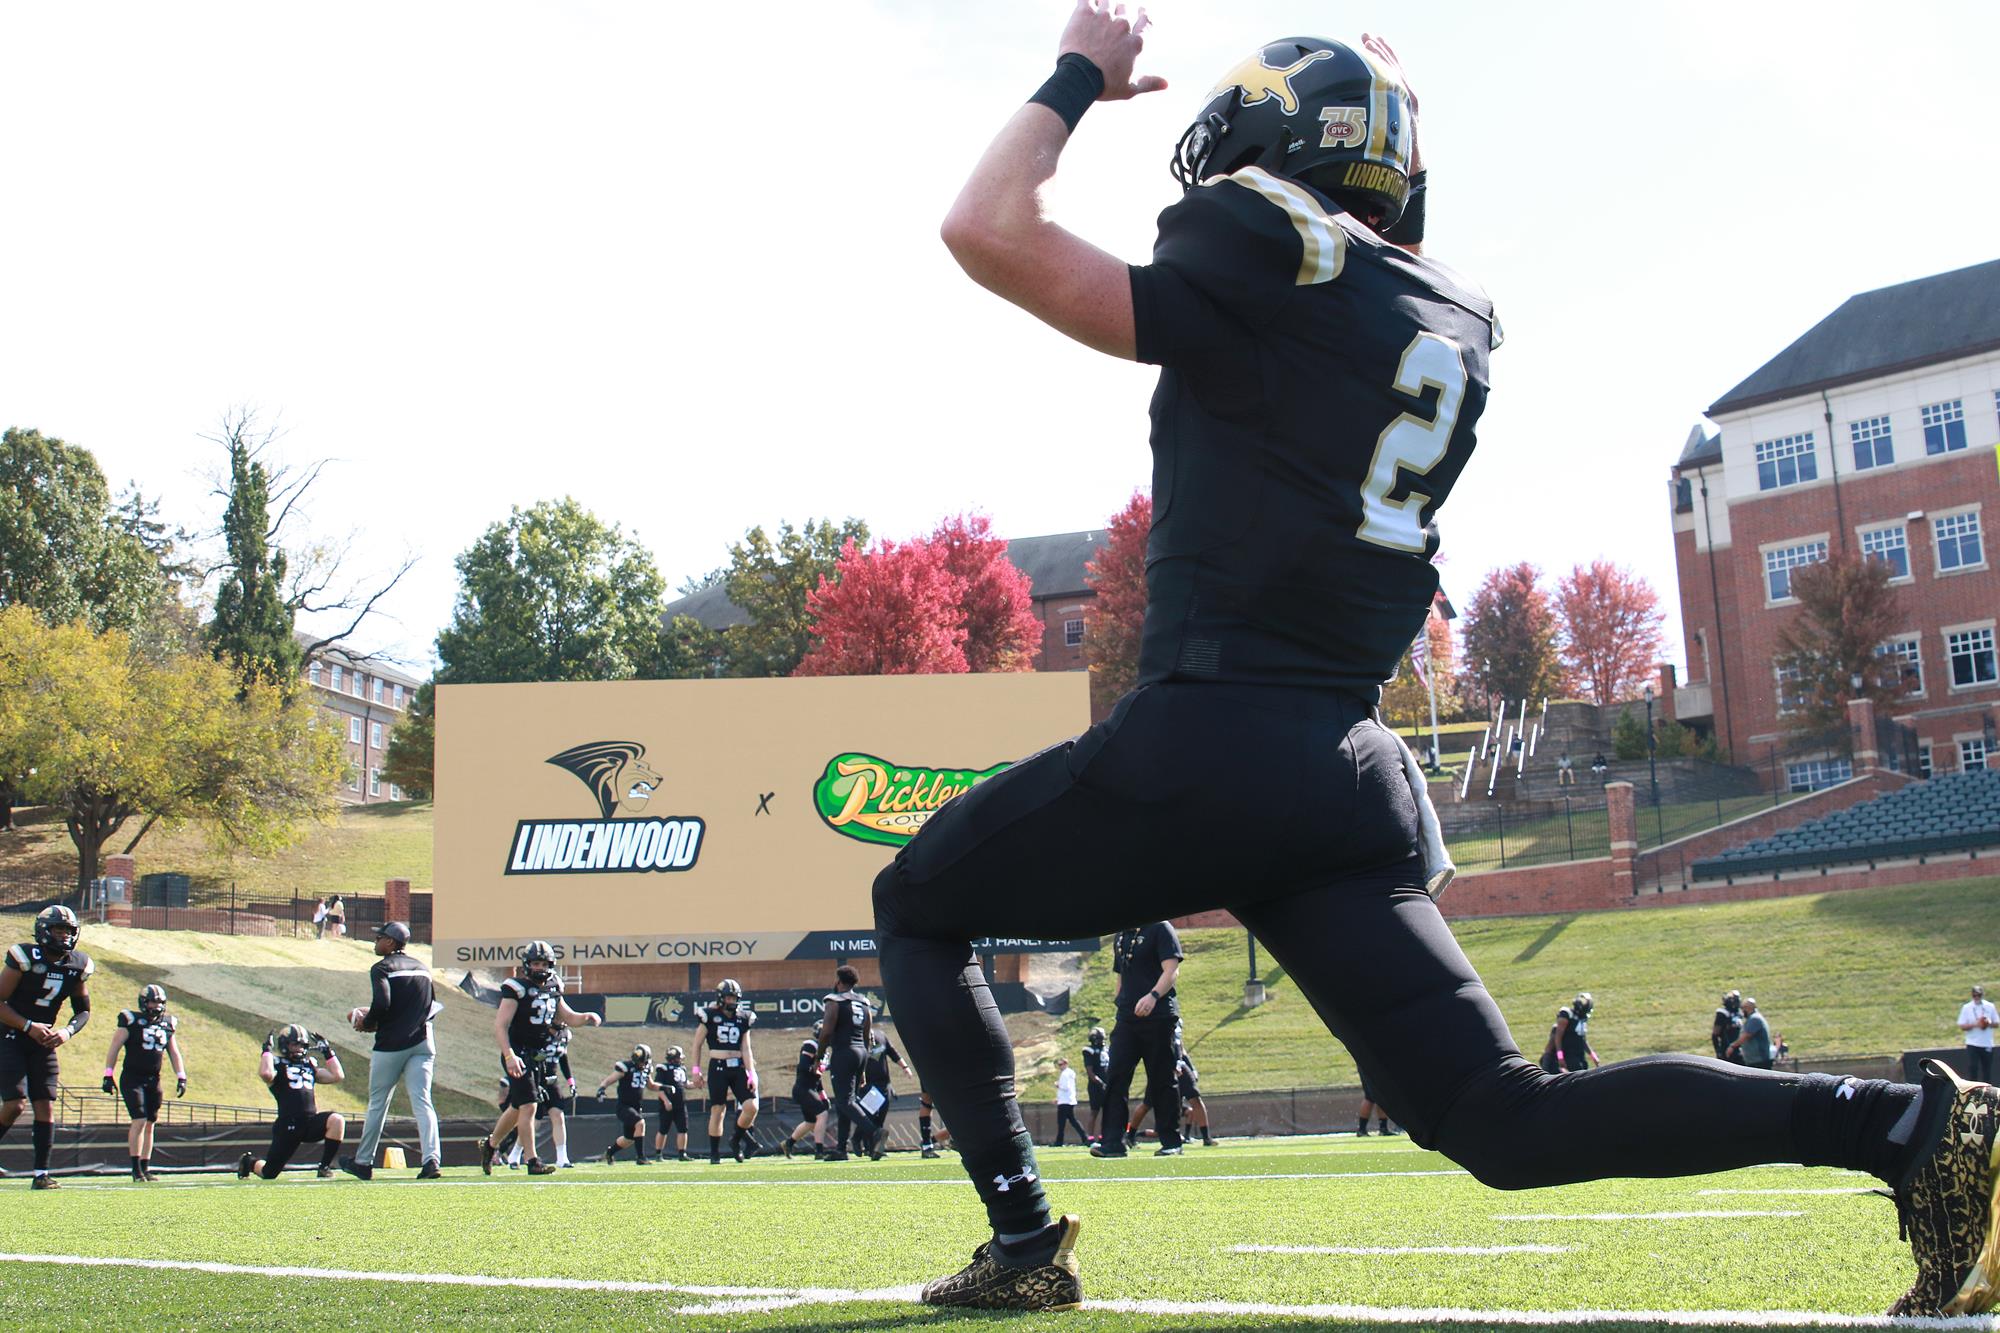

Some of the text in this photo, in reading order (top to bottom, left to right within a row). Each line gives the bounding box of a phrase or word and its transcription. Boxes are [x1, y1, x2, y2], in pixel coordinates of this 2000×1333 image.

[1318, 106, 1368, 148] 75
[1331, 126, 1348, 134] OVC
[1356, 330, 1468, 554] 2
[510, 820, 702, 871] LINDENWOOD
[32, 948, 42, 960] C
[456, 939, 758, 962] SIMMOS HANLY CONROY
[830, 939, 845, 951] IN
[34, 979, 64, 1007] 7
[779, 999, 825, 1014] LION
[851, 1001, 864, 1025] 5
[142, 1027, 167, 1051] 53
